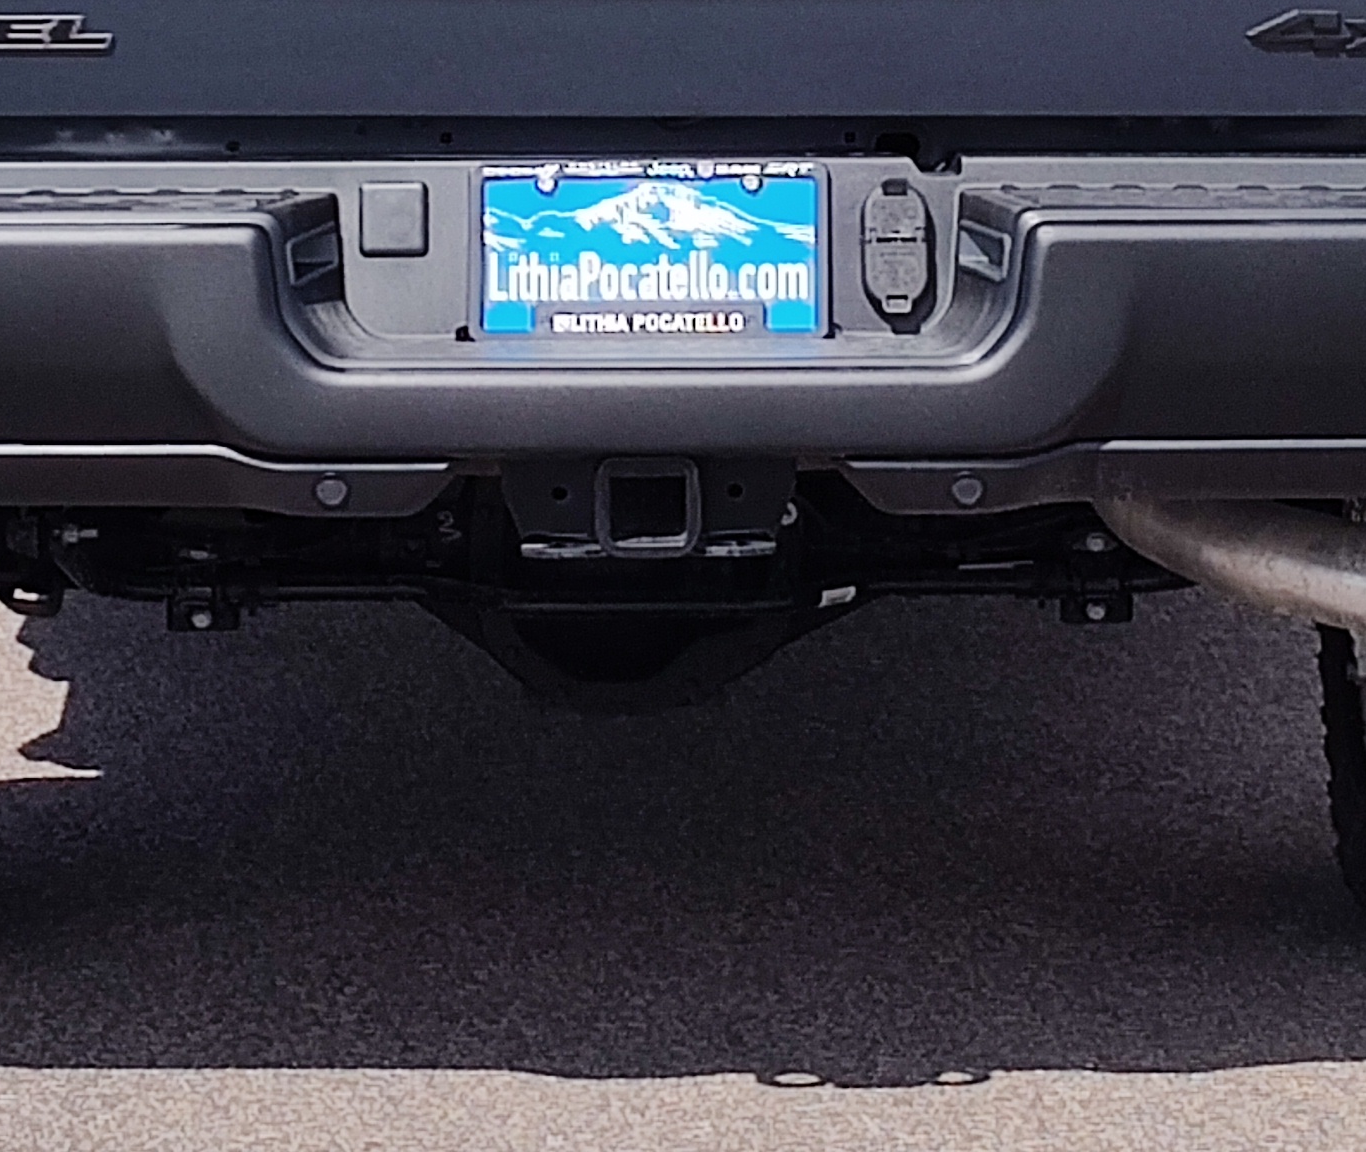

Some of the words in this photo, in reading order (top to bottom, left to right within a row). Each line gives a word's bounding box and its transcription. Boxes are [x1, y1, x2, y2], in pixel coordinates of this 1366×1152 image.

[488, 250, 809, 301] LithiaPocatello.com
[572, 312, 631, 333] LITHIA
[632, 312, 744, 333] POCATELLO
